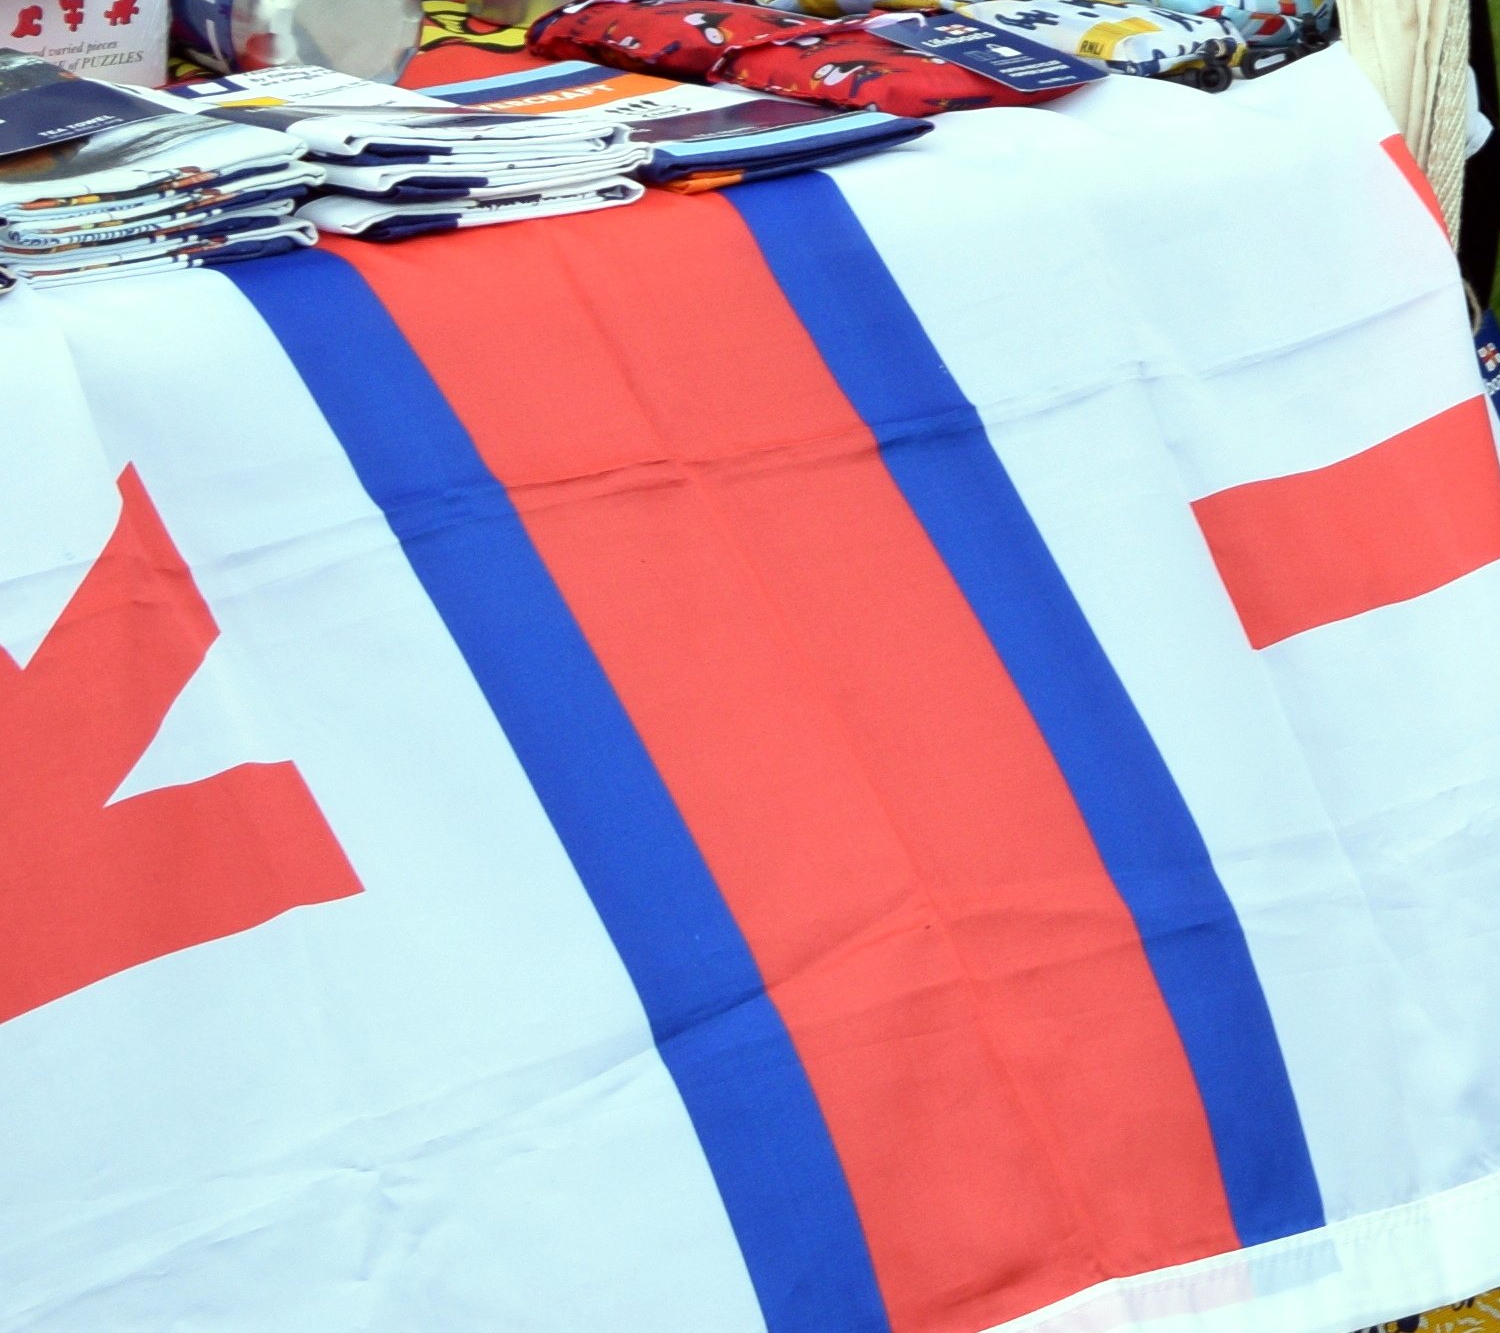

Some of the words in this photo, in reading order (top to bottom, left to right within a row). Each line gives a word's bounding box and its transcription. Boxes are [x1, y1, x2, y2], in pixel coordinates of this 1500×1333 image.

[47, 41, 84, 57] varied
[85, 40, 119, 55] pieces
[81, 50, 146, 70] PUZZLES
